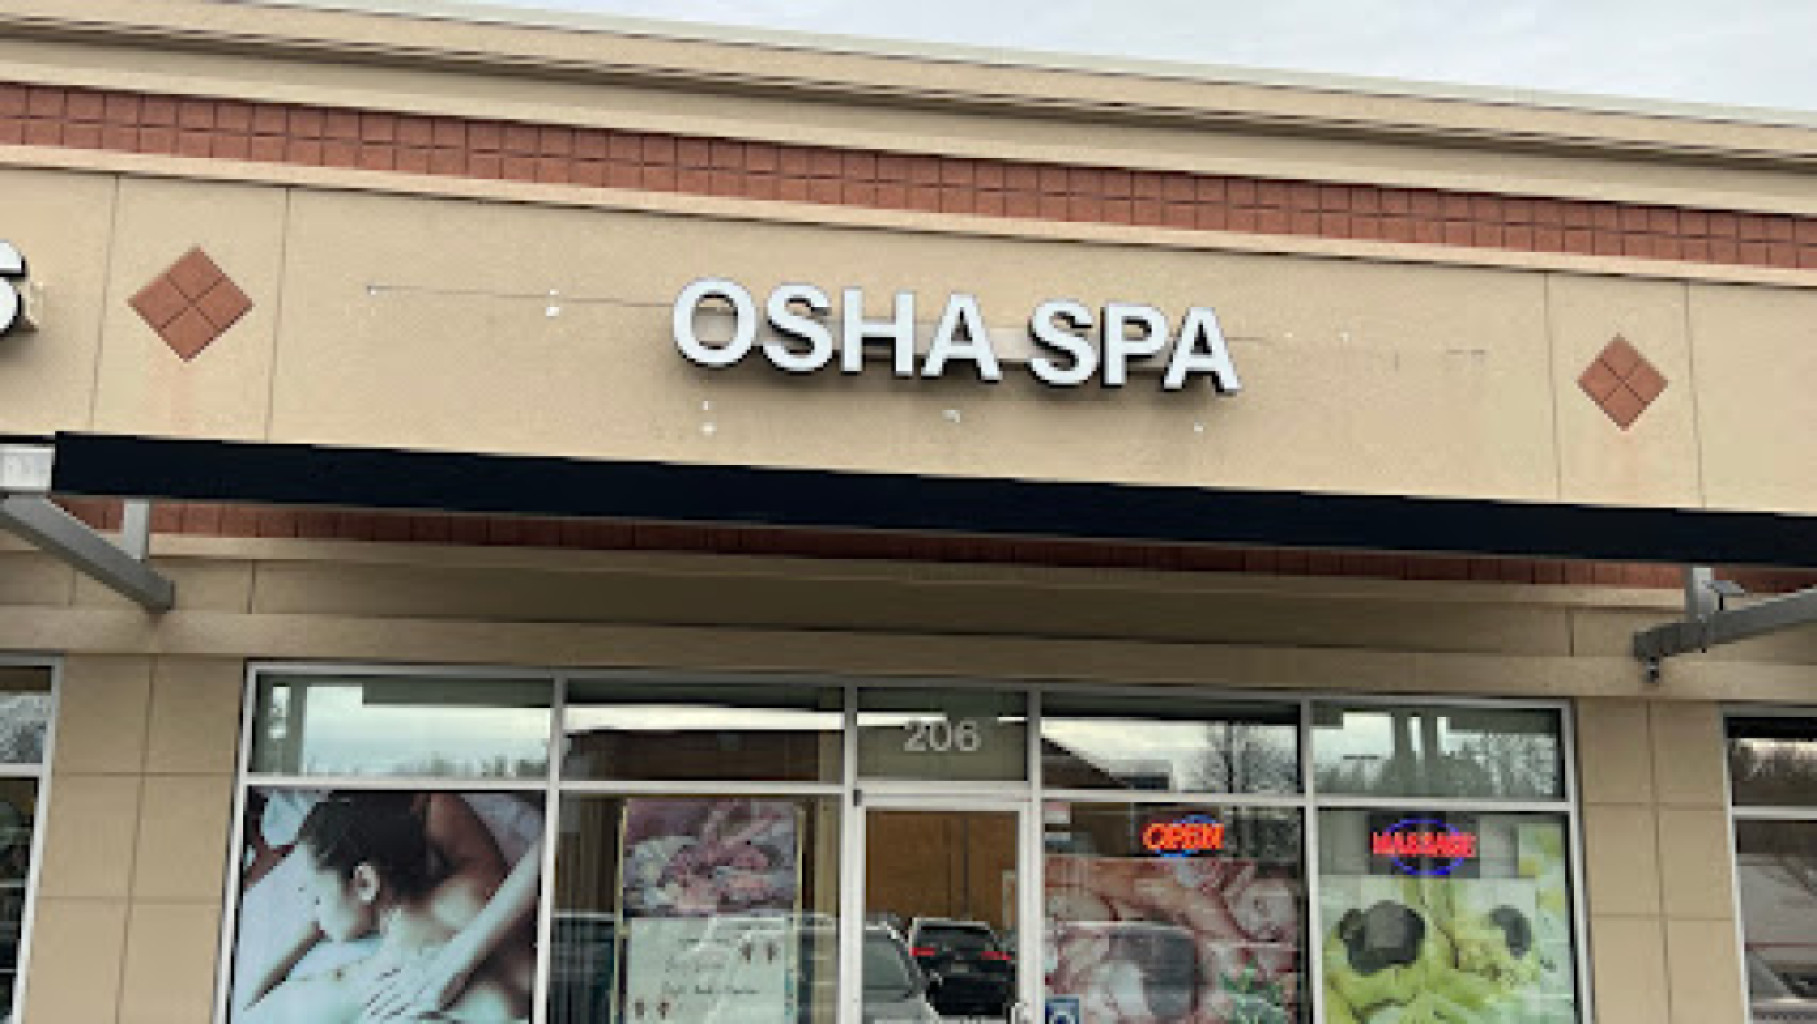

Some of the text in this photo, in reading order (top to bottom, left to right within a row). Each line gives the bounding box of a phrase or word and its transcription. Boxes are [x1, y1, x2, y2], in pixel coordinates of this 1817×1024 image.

[672, 277, 1241, 394] OSHA SPA
[903, 720, 981, 752] 206
[1142, 822, 1224, 850] OPEN
[1372, 831, 1477, 857] MASSAGE
